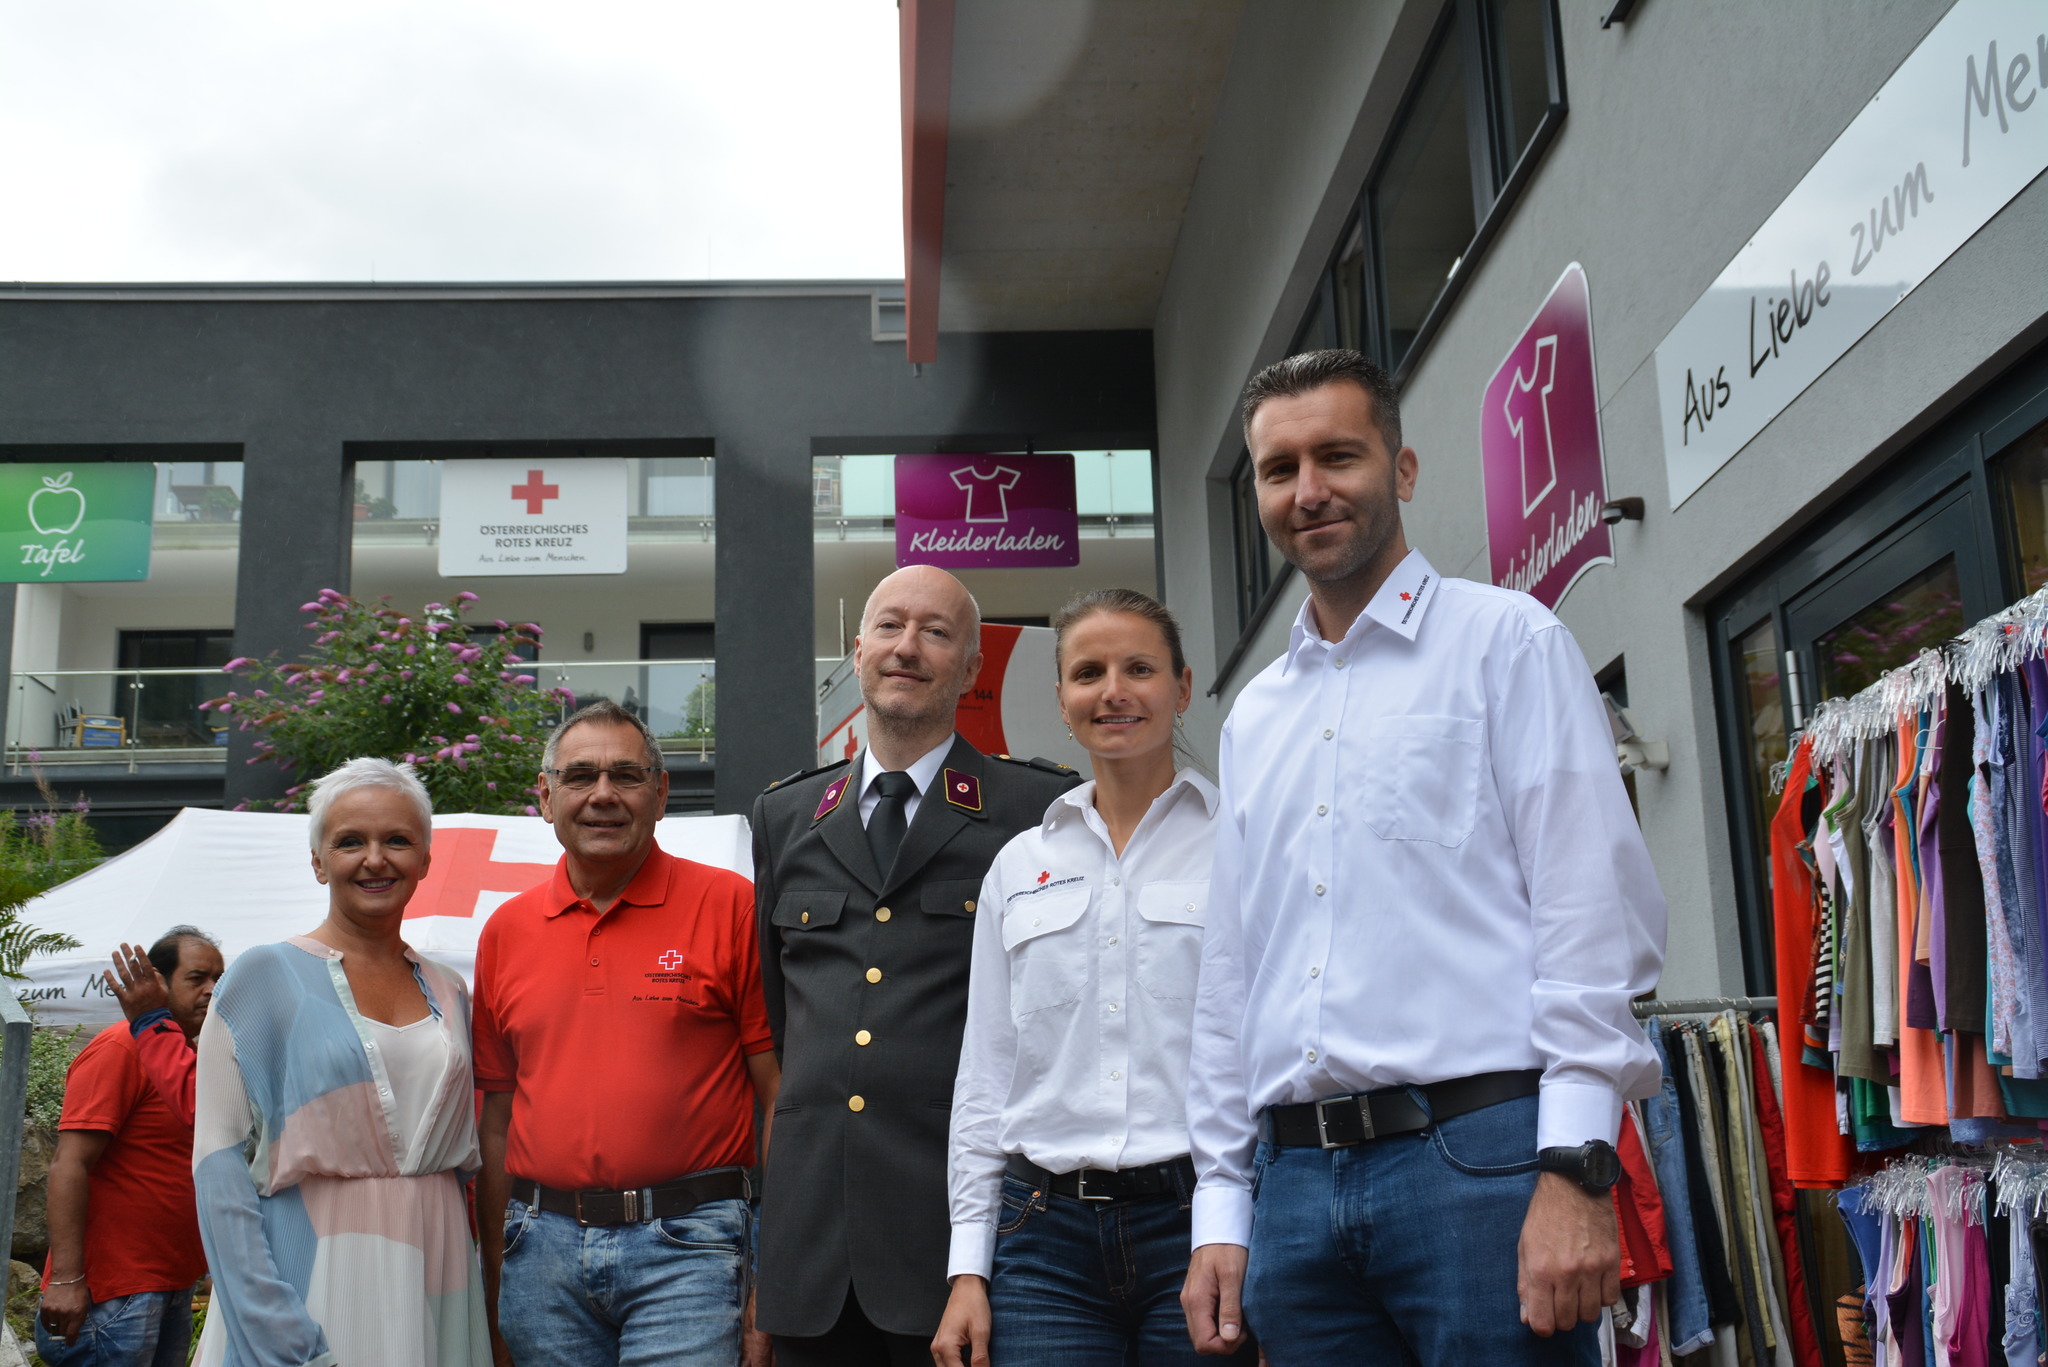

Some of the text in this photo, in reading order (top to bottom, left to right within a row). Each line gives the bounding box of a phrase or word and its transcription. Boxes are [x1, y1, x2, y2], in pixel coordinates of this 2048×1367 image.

[1683, 366, 1731, 446] Aus
[1749, 260, 1831, 379] Liebe
[1849, 161, 1935, 277] zum
[480, 524, 589, 535] ÖSTERREICHISCHES
[495, 537, 573, 548] ROTES KREUZ
[910, 526, 1065, 552] Kleiderladen
[20, 539, 85, 577] Tafel
[973, 689, 993, 700] 144
[1050, 879, 1066, 888] ROTES
[1066, 876, 1085, 884] KREUZ
[18, 987, 67, 1001] zum
